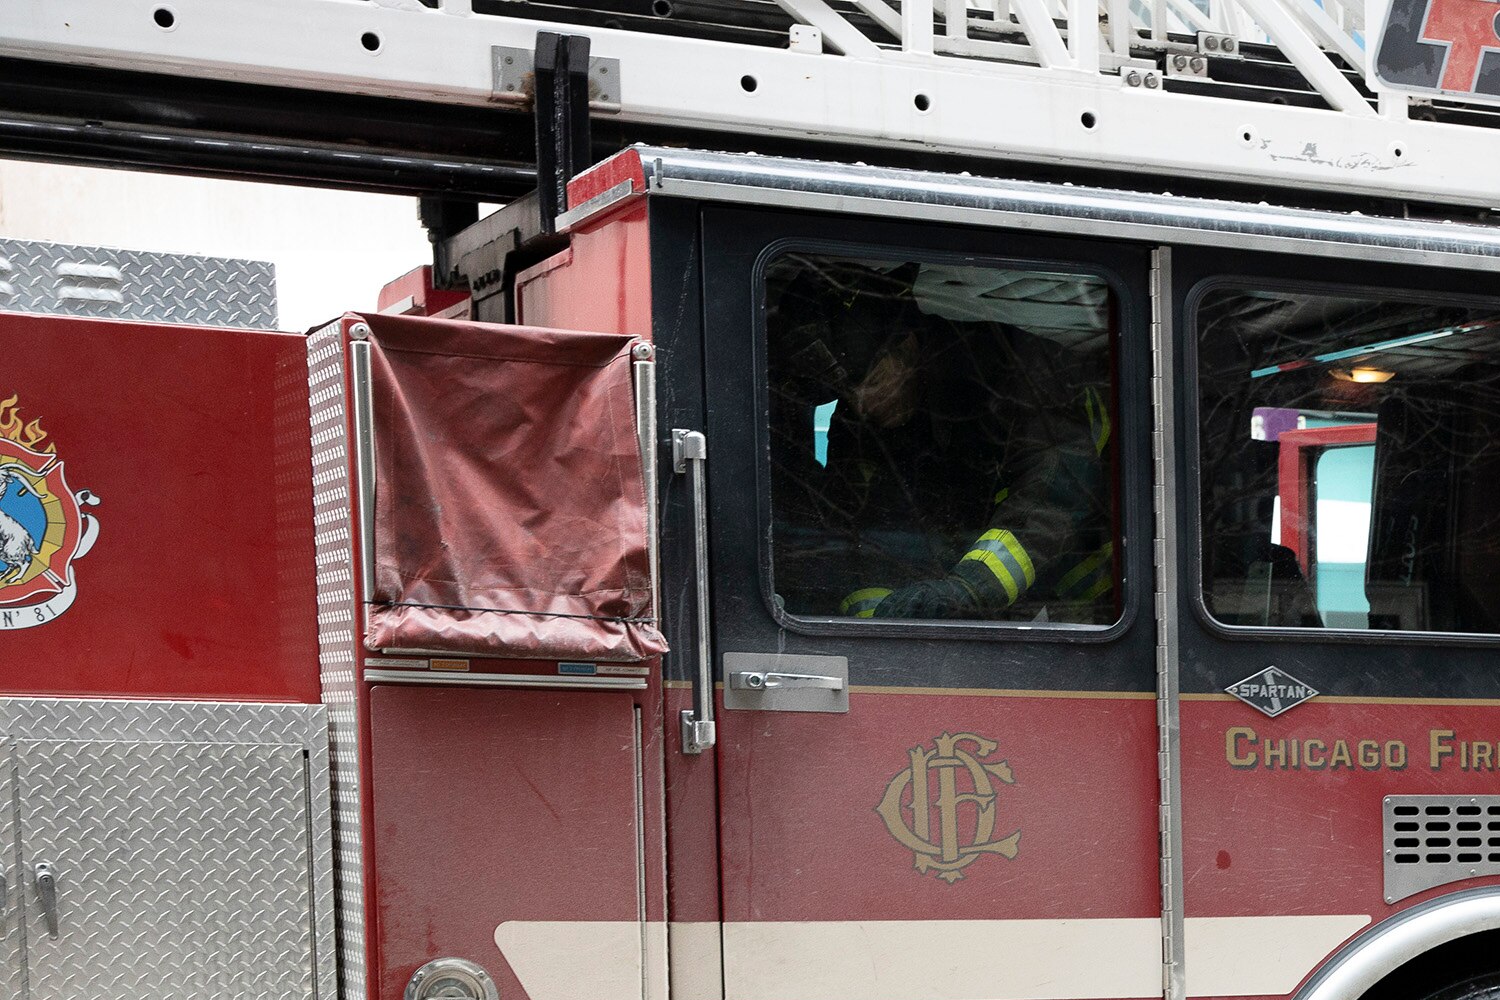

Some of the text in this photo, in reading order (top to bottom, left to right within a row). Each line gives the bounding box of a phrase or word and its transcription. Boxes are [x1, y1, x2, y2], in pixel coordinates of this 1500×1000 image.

[33, 603, 57, 622] 81
[1239, 684, 1306, 699] SPARTAN
[1225, 726, 1407, 771] CHICAGO
